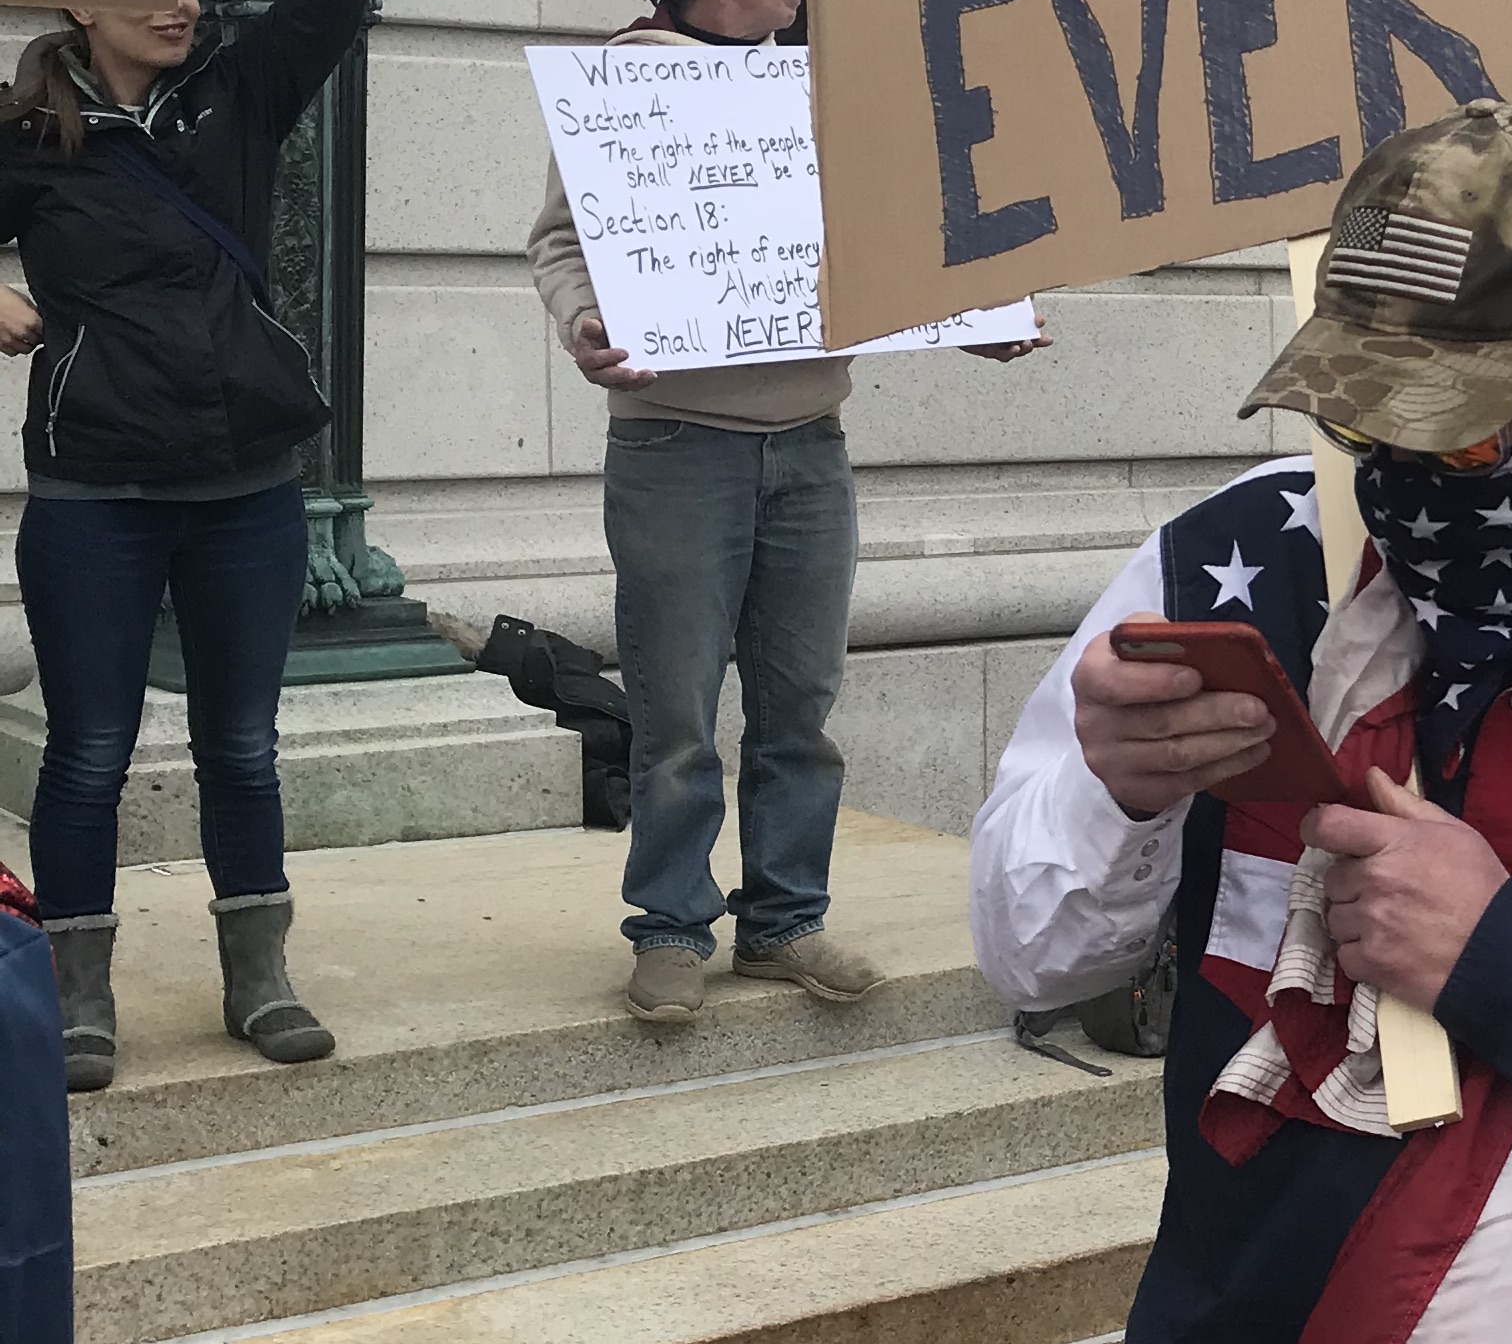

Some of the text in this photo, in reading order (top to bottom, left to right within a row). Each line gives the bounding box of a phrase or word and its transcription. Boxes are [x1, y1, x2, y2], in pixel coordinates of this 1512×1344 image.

[570, 48, 733, 88] Wisconsin
[554, 97, 645, 136] Section
[599, 125, 809, 170] The right of the people
[626, 166, 672, 190] shall
[688, 163, 756, 185] NEVER
[770, 159, 793, 181] be
[580, 191, 730, 242] Section 18:
[626, 237, 822, 279] The right of every
[643, 309, 823, 357] shall NEVER
